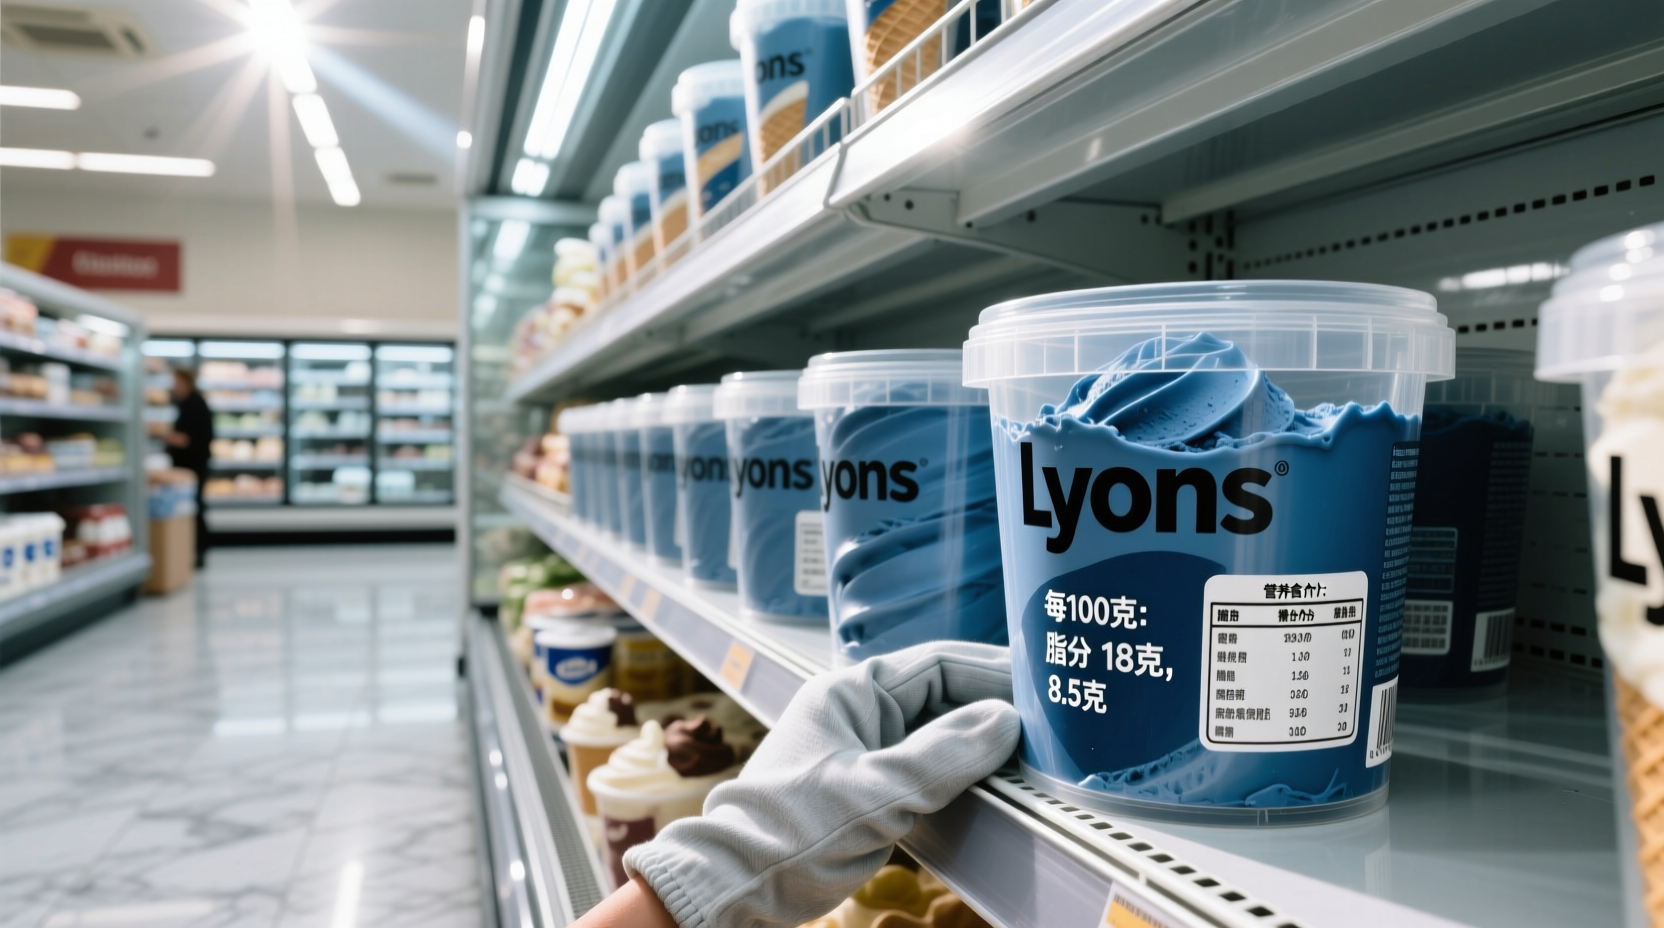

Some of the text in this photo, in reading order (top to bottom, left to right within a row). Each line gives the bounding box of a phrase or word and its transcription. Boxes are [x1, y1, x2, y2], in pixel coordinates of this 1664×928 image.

[1020, 441, 1274, 554] Lyons
[1045, 631, 1174, 682] 脂分 18克,
[1047, 674, 1108, 714] 8.5克
